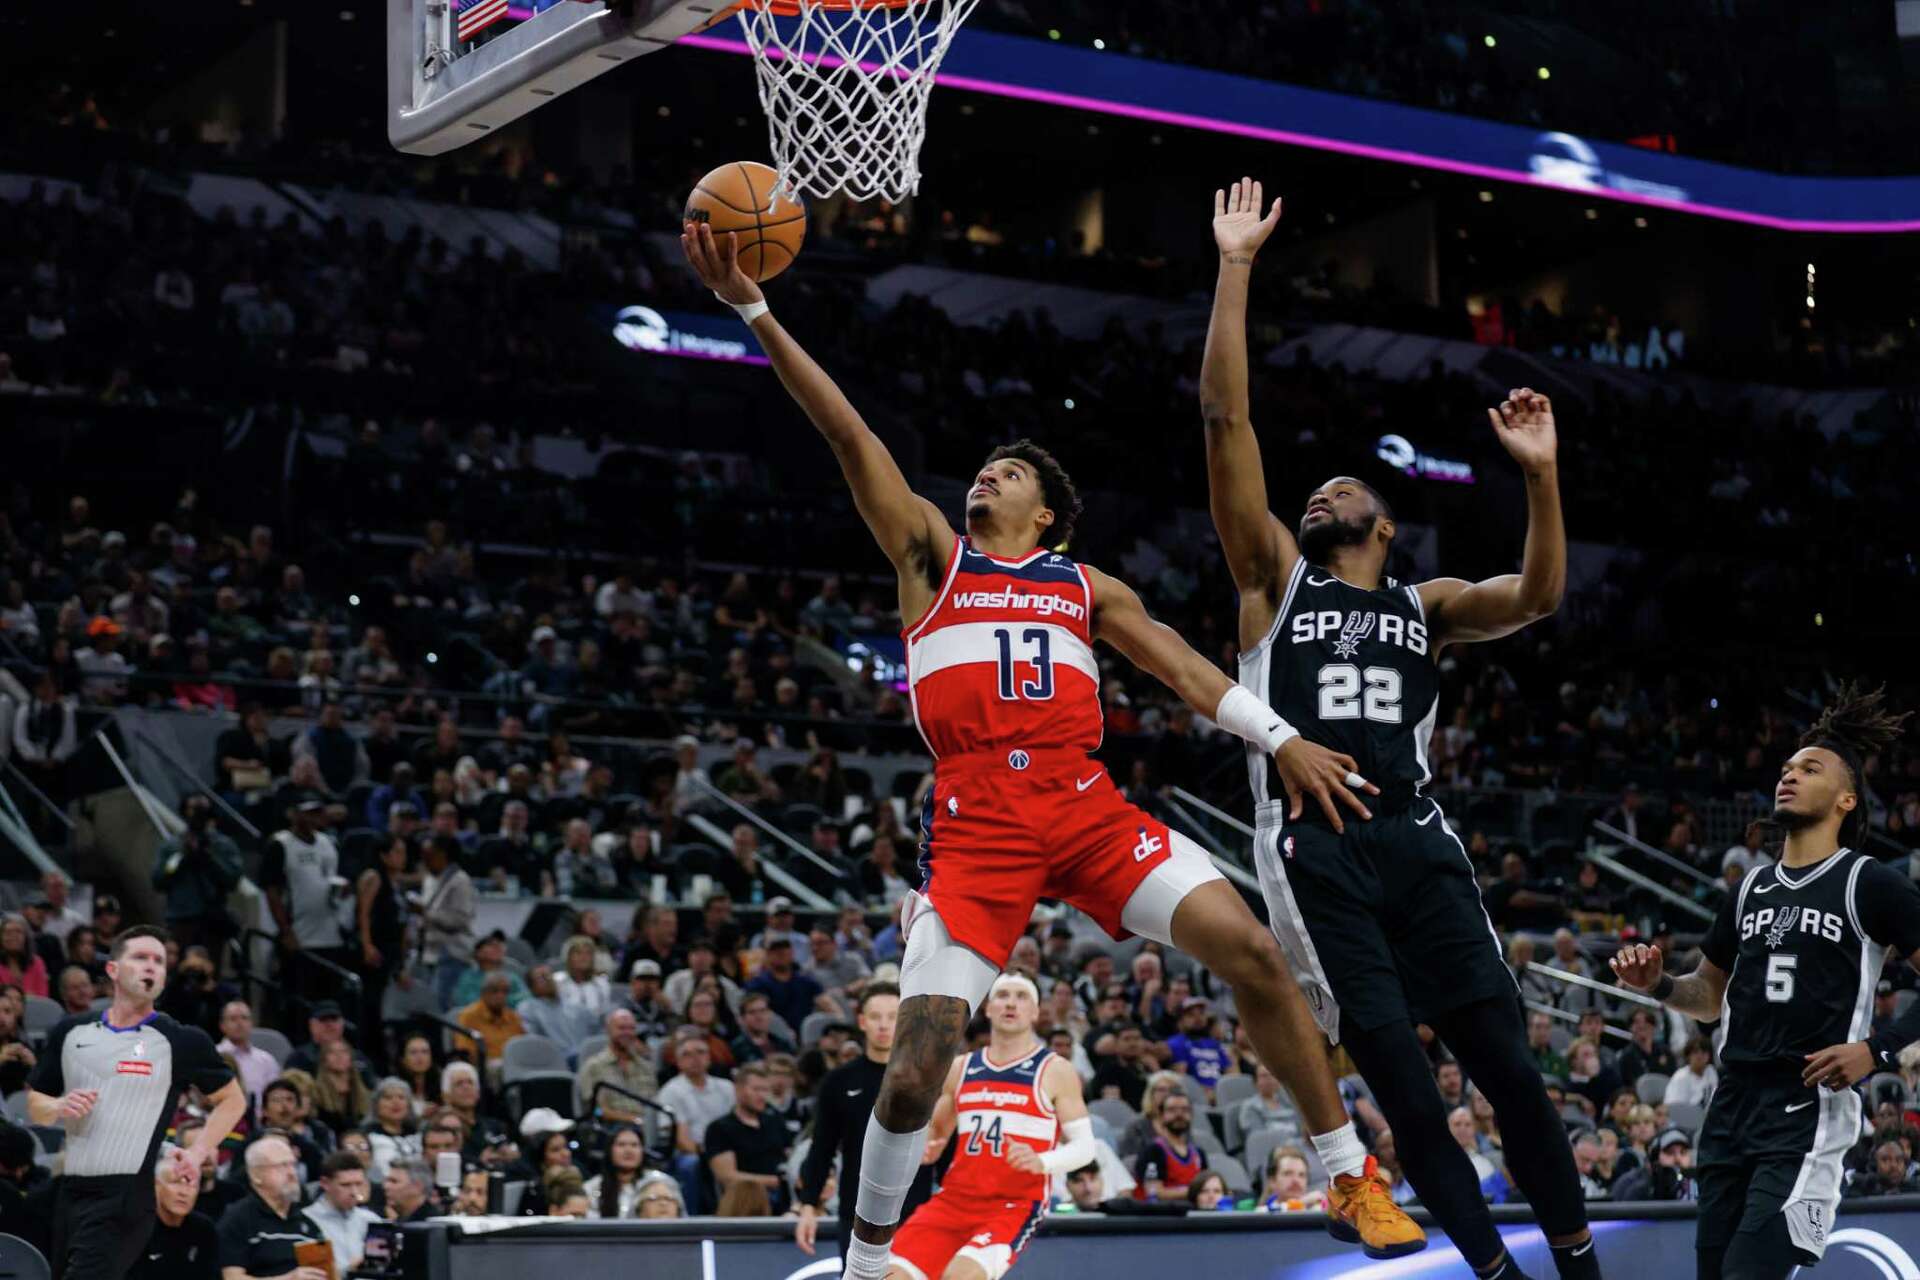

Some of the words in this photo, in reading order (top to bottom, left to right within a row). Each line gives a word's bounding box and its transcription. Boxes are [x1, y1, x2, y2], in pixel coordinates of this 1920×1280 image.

[953, 584, 1085, 621] washington
[1292, 610, 1428, 659] SPURS
[993, 627, 1054, 700] 13
[1318, 663, 1402, 724] 22
[1741, 906, 1843, 949] SPURS
[1765, 953, 1798, 1003] 5
[966, 1114, 1004, 1156] 24
